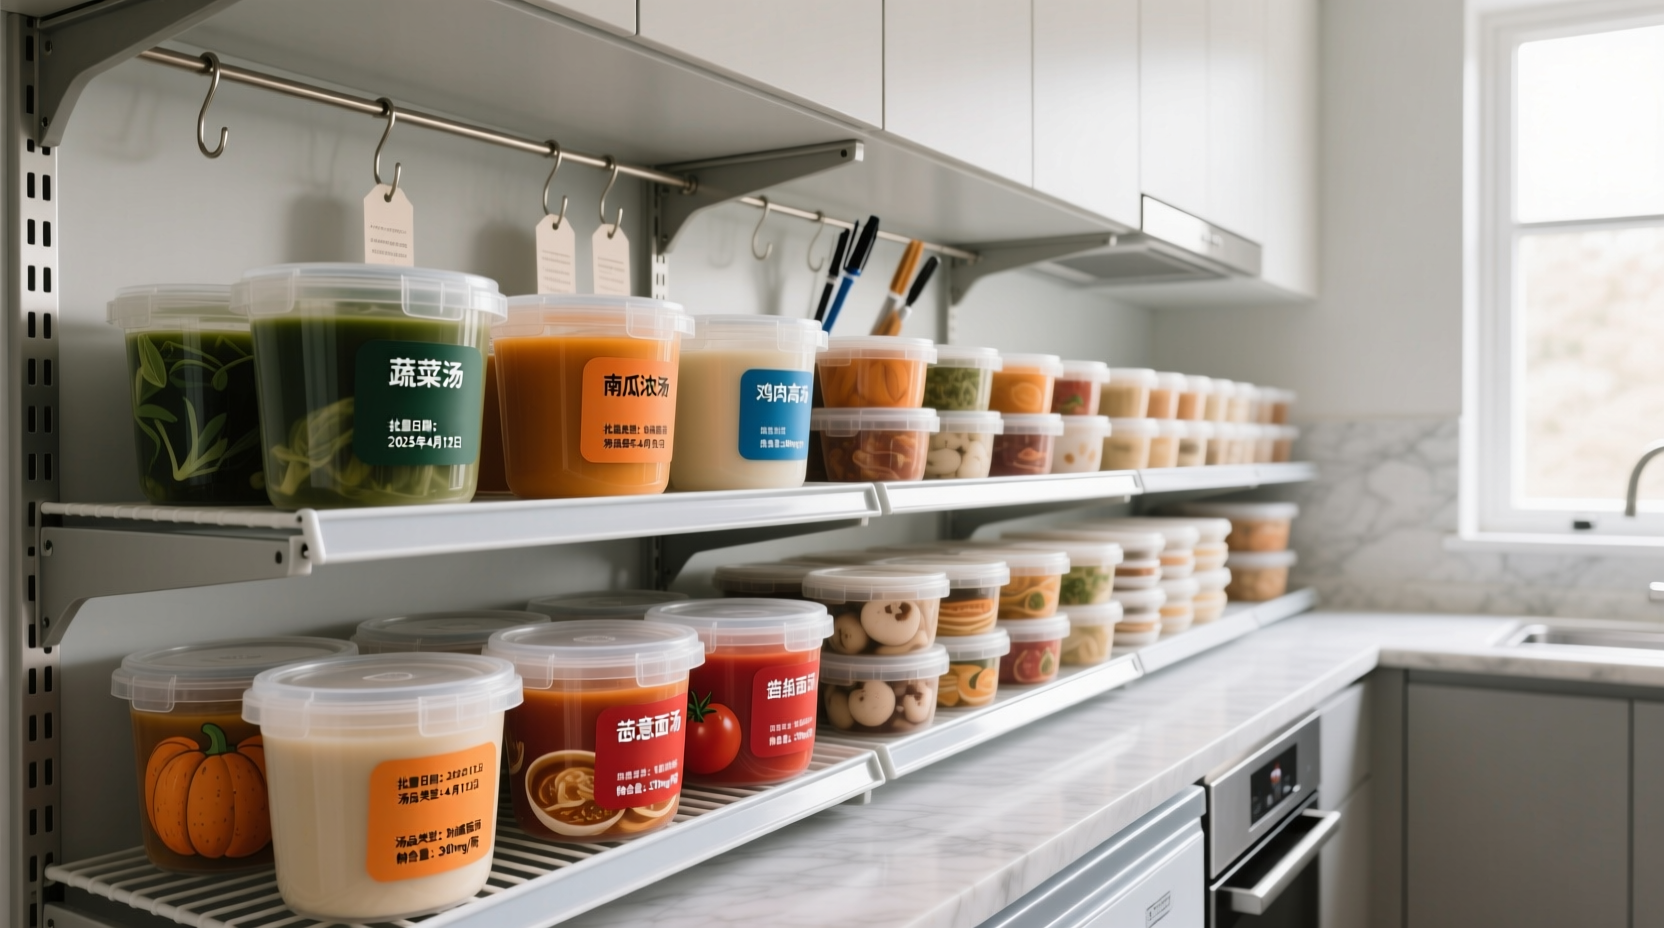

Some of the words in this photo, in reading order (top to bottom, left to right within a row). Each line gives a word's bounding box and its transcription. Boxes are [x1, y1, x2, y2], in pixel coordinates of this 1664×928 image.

[389, 357, 463, 389] 蔬菜汤
[604, 373, 669, 397] 南瓜浓汤
